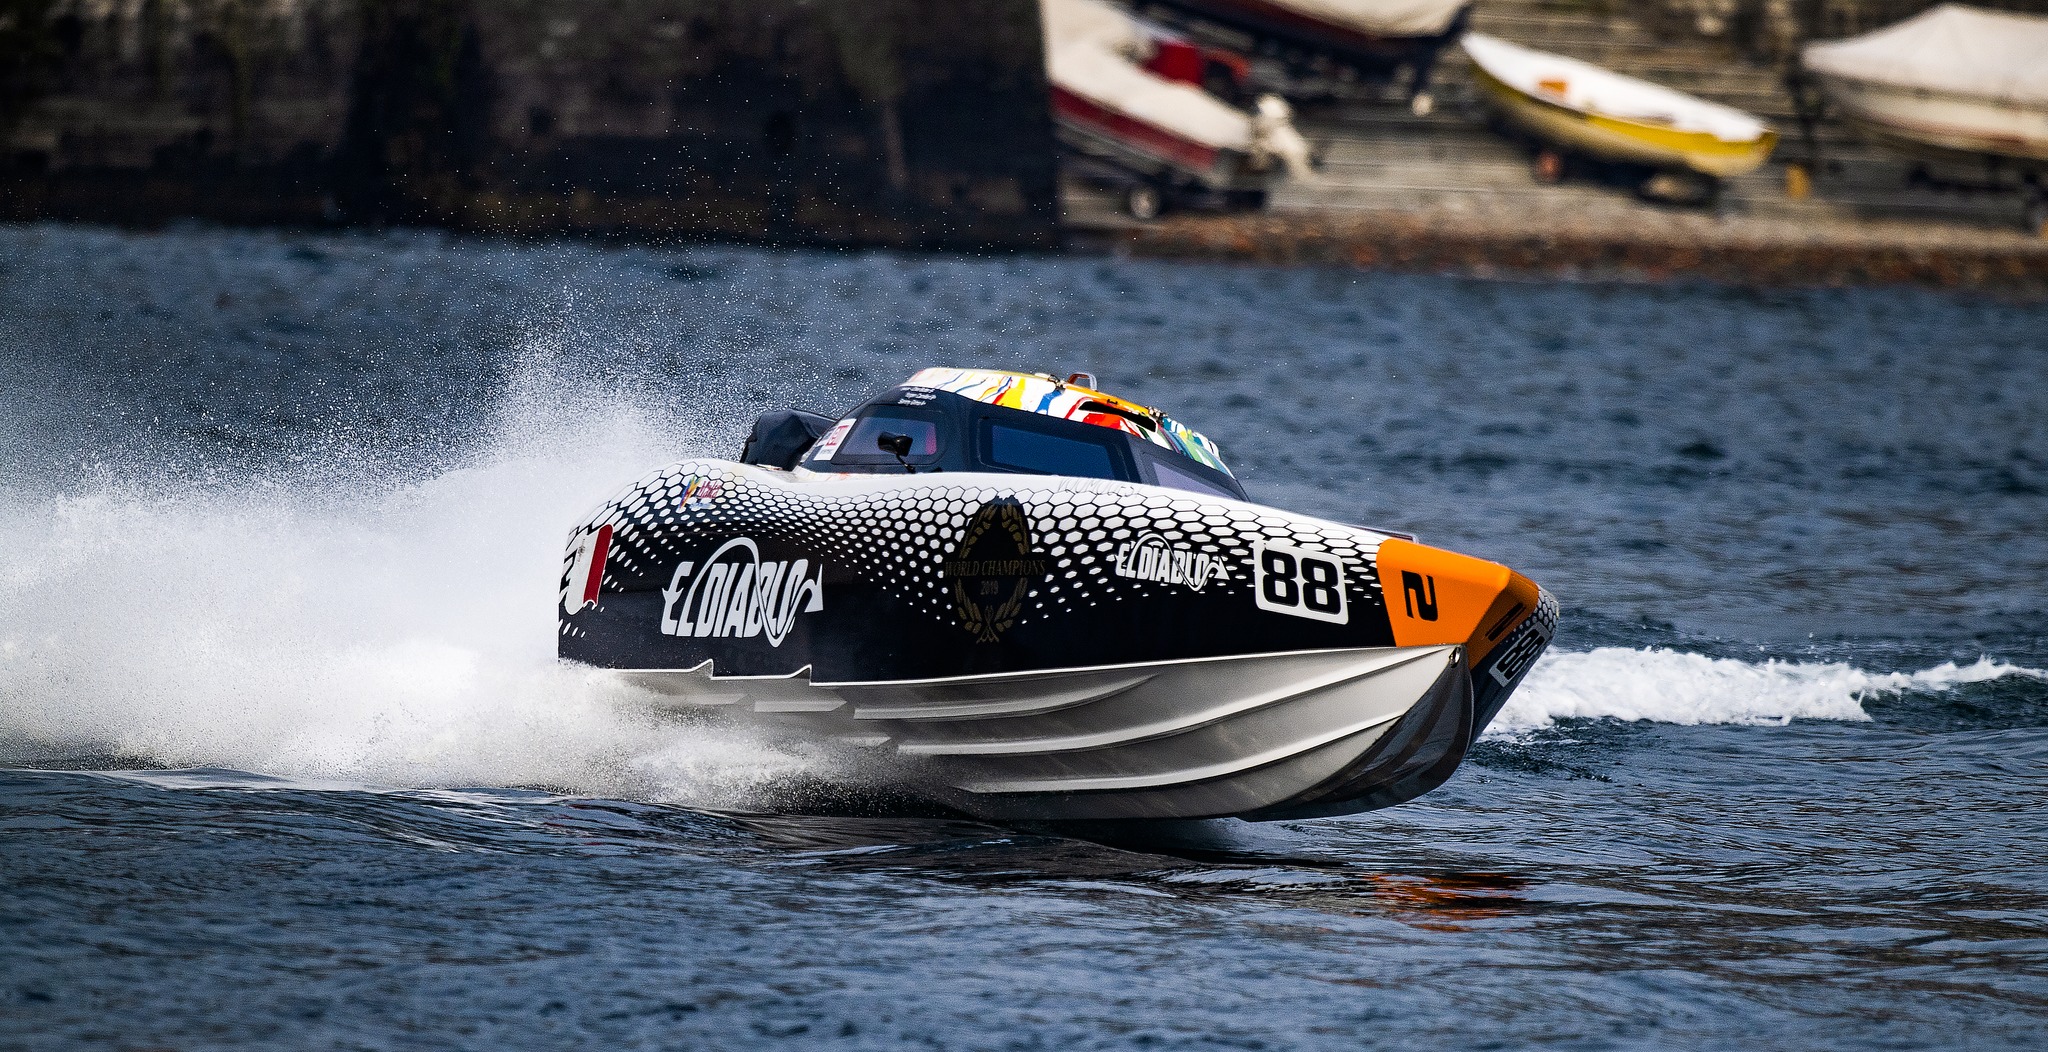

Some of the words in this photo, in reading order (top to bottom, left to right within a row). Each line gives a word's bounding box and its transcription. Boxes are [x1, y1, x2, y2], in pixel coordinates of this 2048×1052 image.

[944, 560, 979, 577] WORLD
[981, 559, 1047, 576] CHAMPIONS
[979, 579, 999, 596] 2019
[1261, 549, 1341, 615] 88
